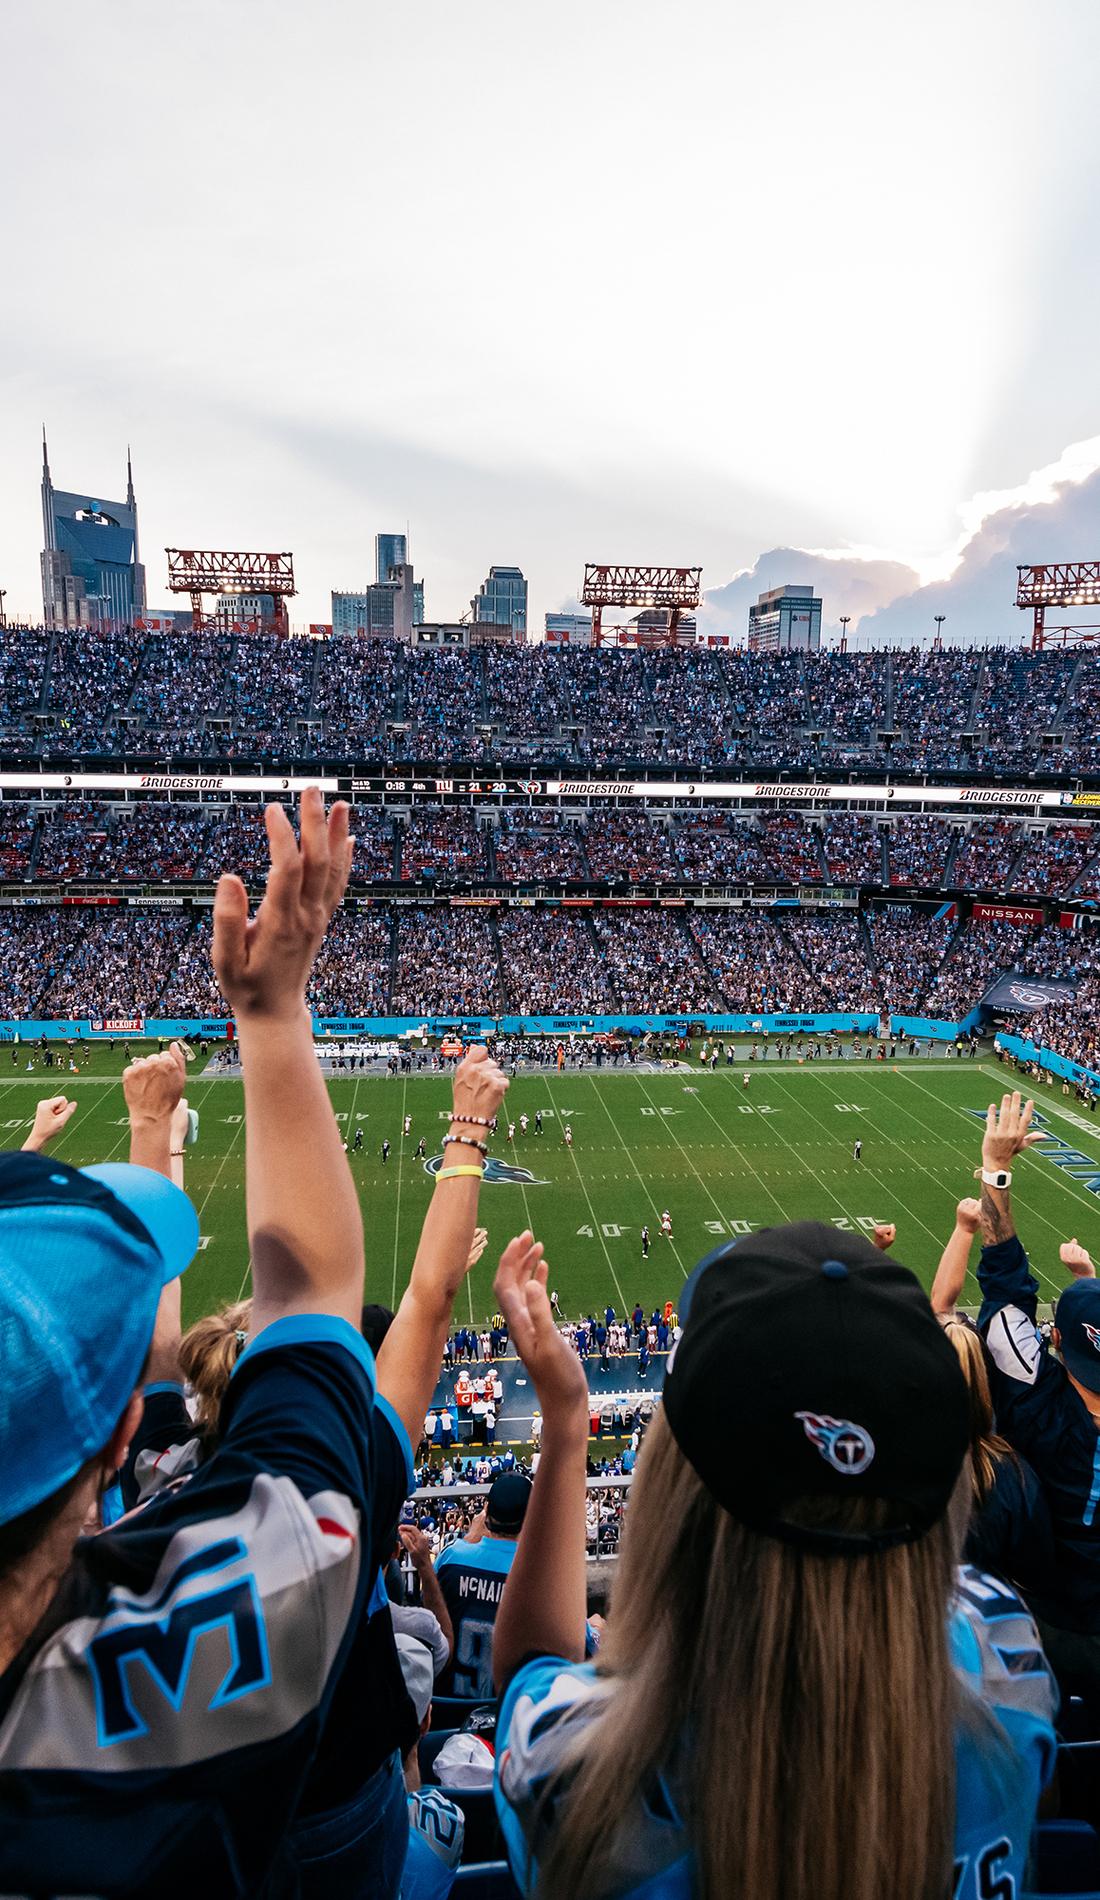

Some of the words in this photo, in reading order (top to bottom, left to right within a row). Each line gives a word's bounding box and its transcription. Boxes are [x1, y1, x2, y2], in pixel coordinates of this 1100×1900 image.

[140, 776, 223, 788] BRIDGESTONE
[385, 782, 405, 790] 0:18
[559, 783, 635, 794] BRIDGESTONE
[755, 786, 831, 796] BRIDGESTONE
[959, 790, 1045, 803] BRIDGESTONE
[982, 908, 1034, 920] NISSAN
[1012, 981, 1068, 993] NISSAN
[993, 1005, 1021, 1014] NISSAN
[106, 1020, 138, 1029] KICKOFF
[577, 1224, 621, 1237] 40
